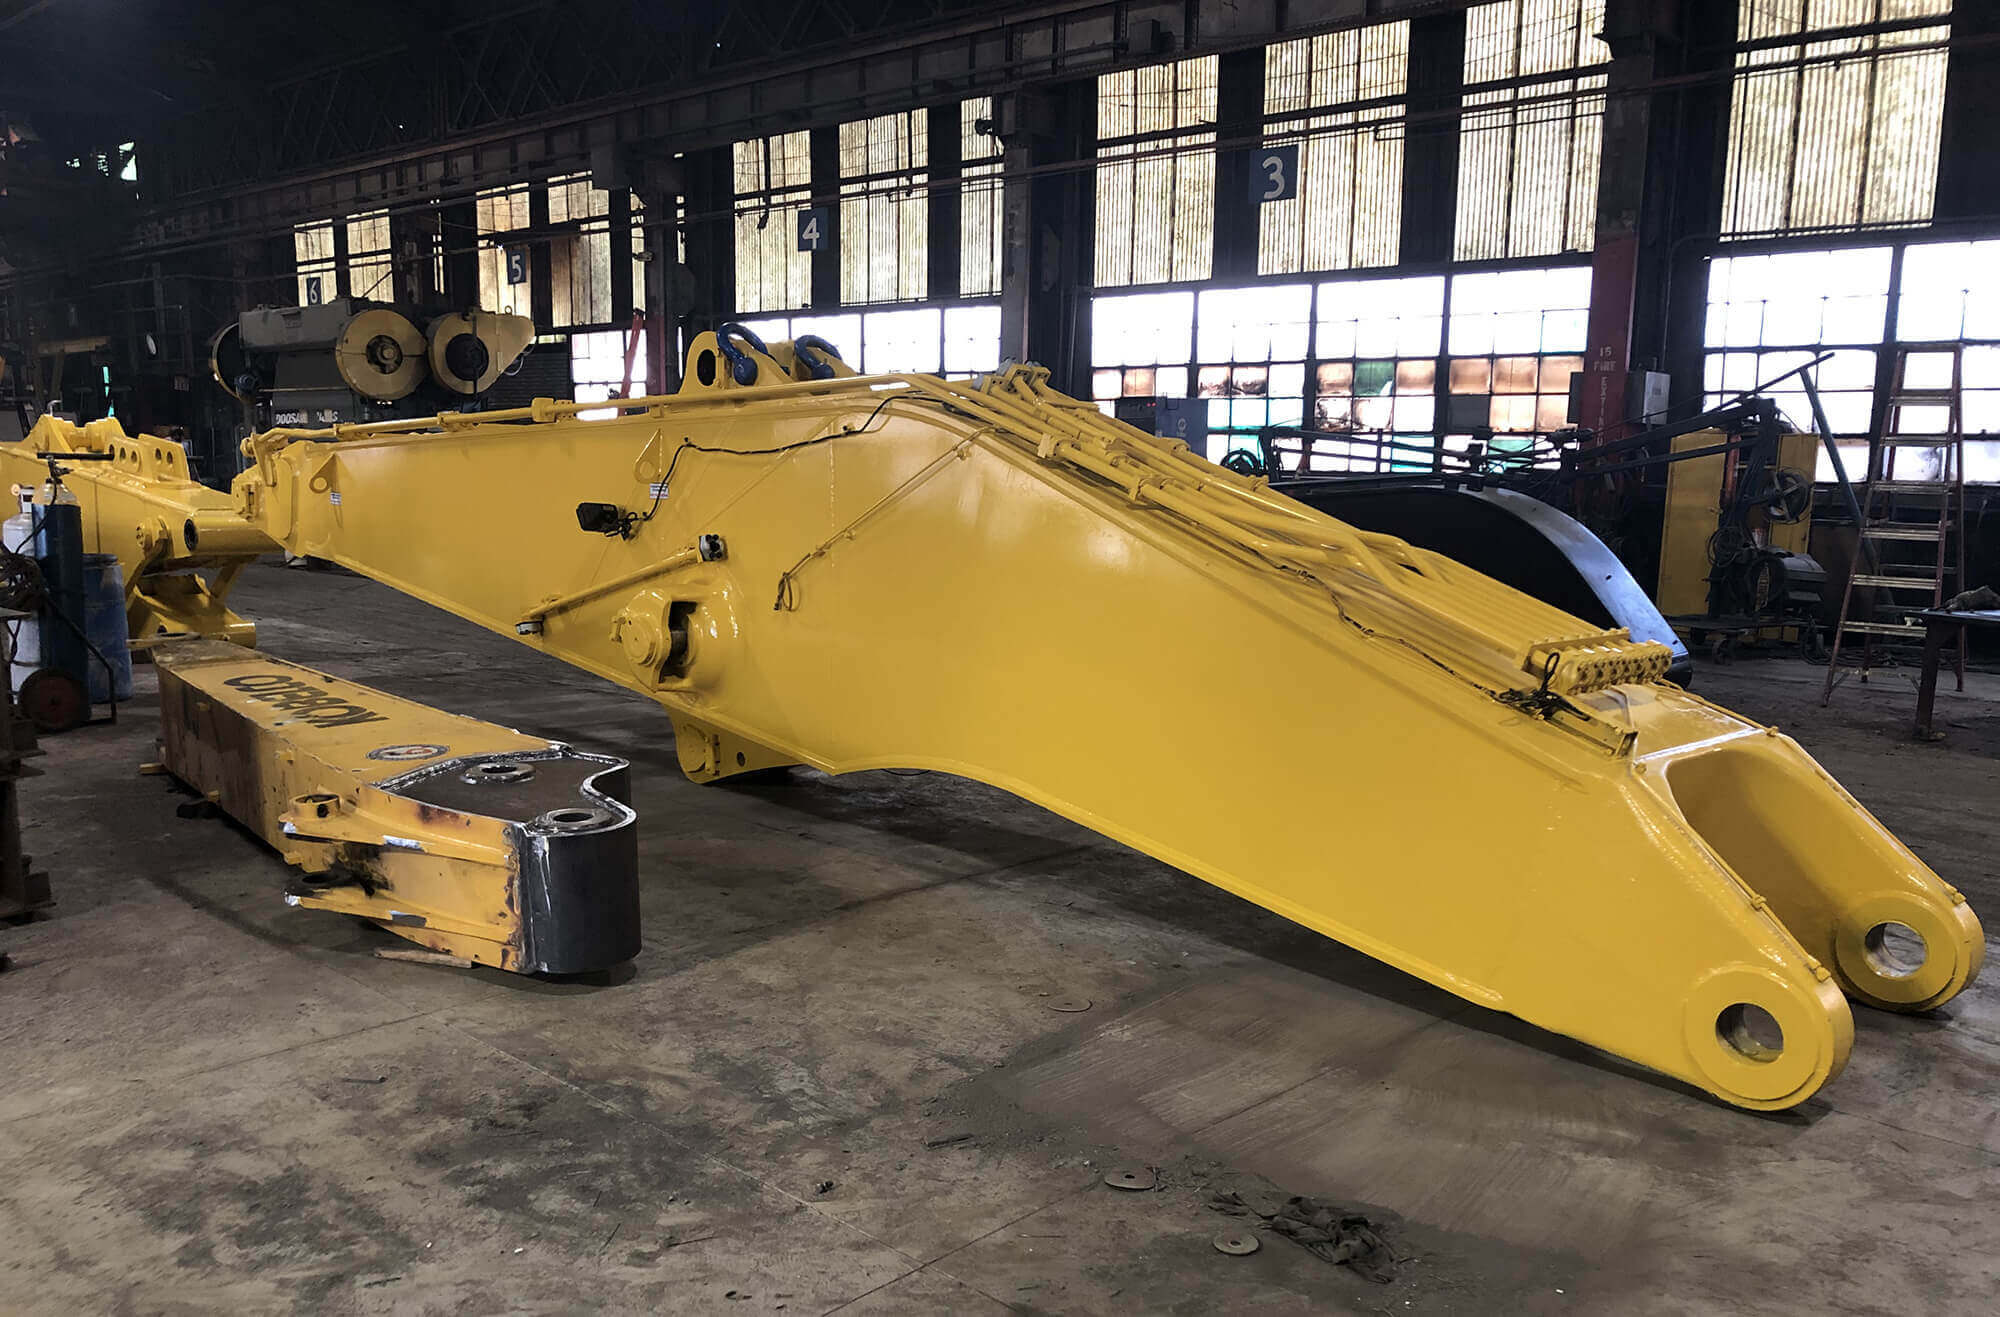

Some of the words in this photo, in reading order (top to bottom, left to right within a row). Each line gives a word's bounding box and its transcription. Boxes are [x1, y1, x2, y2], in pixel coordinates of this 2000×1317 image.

[1263, 156, 1285, 199] 3
[802, 217, 820, 249] 4
[512, 254, 522, 282] 5
[311, 280, 317, 303] 6
[1593, 360, 1617, 372] FIRE
[224, 675, 390, 728] KOBELCO
